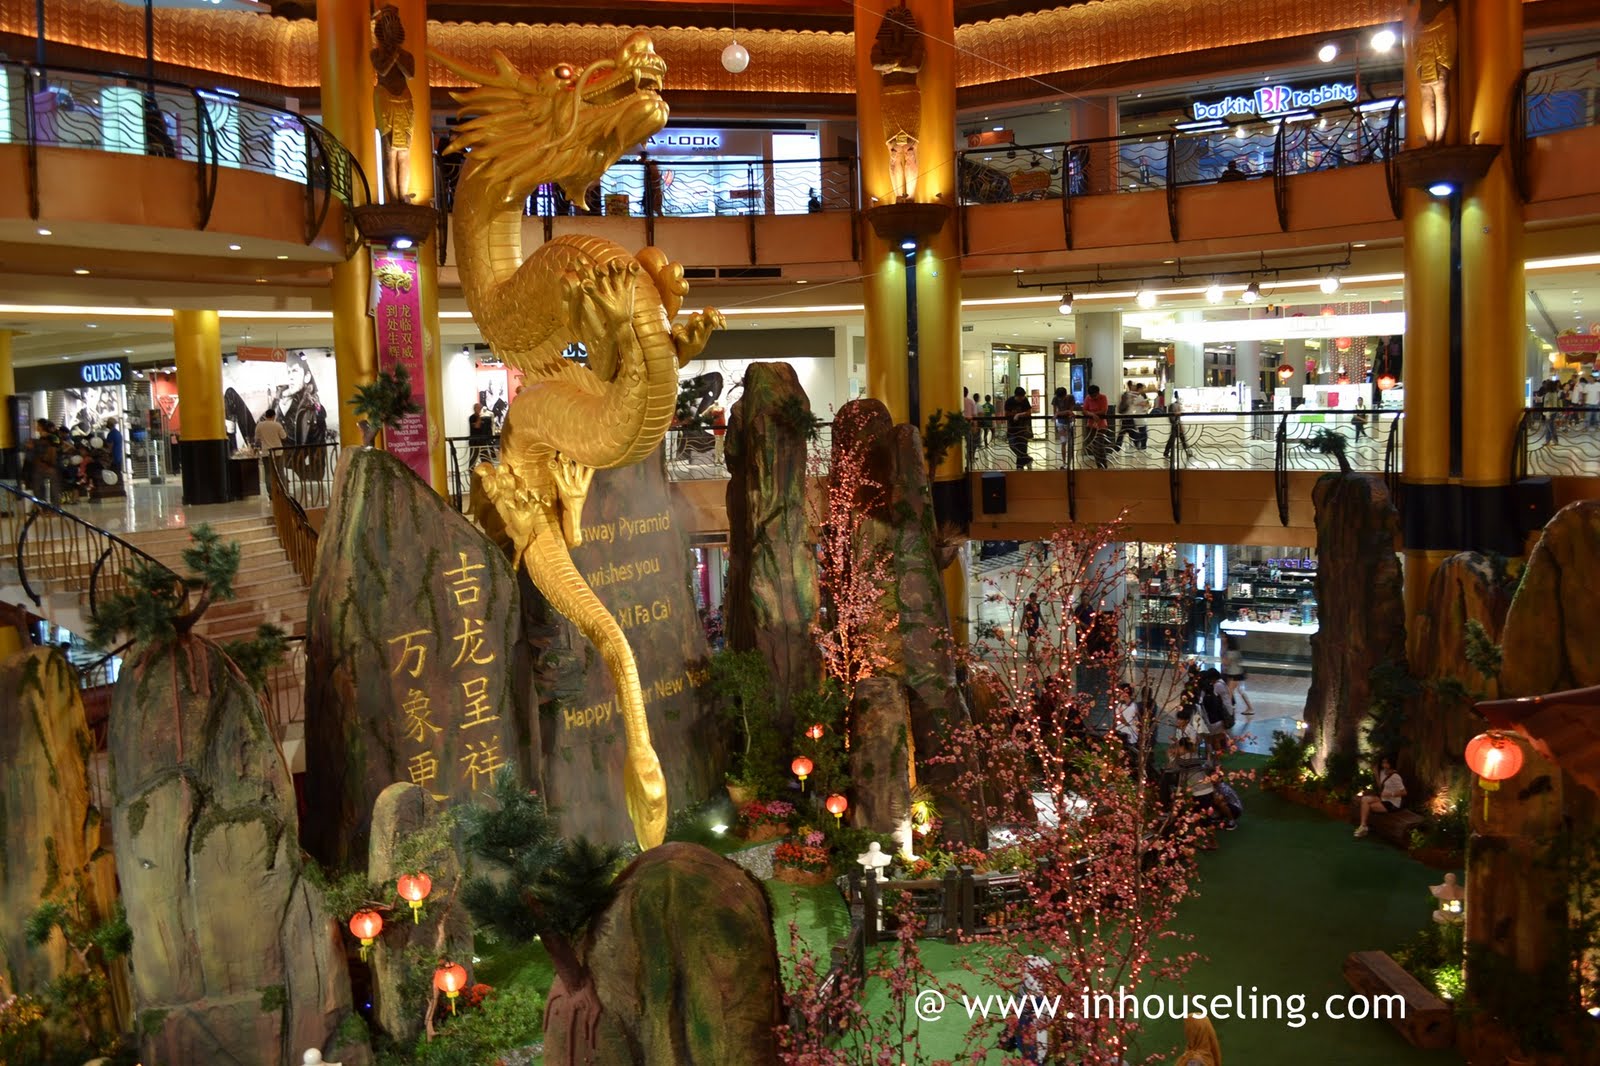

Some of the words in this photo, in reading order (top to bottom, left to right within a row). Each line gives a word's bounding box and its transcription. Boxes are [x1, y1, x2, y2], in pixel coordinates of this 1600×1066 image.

[385, 304, 400, 359] 到处生辉
[400, 304, 414, 359] 龙临双威
[83, 363, 122, 382] GUESS
[618, 509, 671, 541] Pyramid
[588, 563, 633, 587] wishes
[634, 557, 661, 582] you
[634, 603, 650, 625] Fa
[651, 599, 672, 621] Cai
[443, 552, 504, 791] 吉龙呈祥
[563, 699, 612, 730] Happy
[654, 677, 684, 698] New
